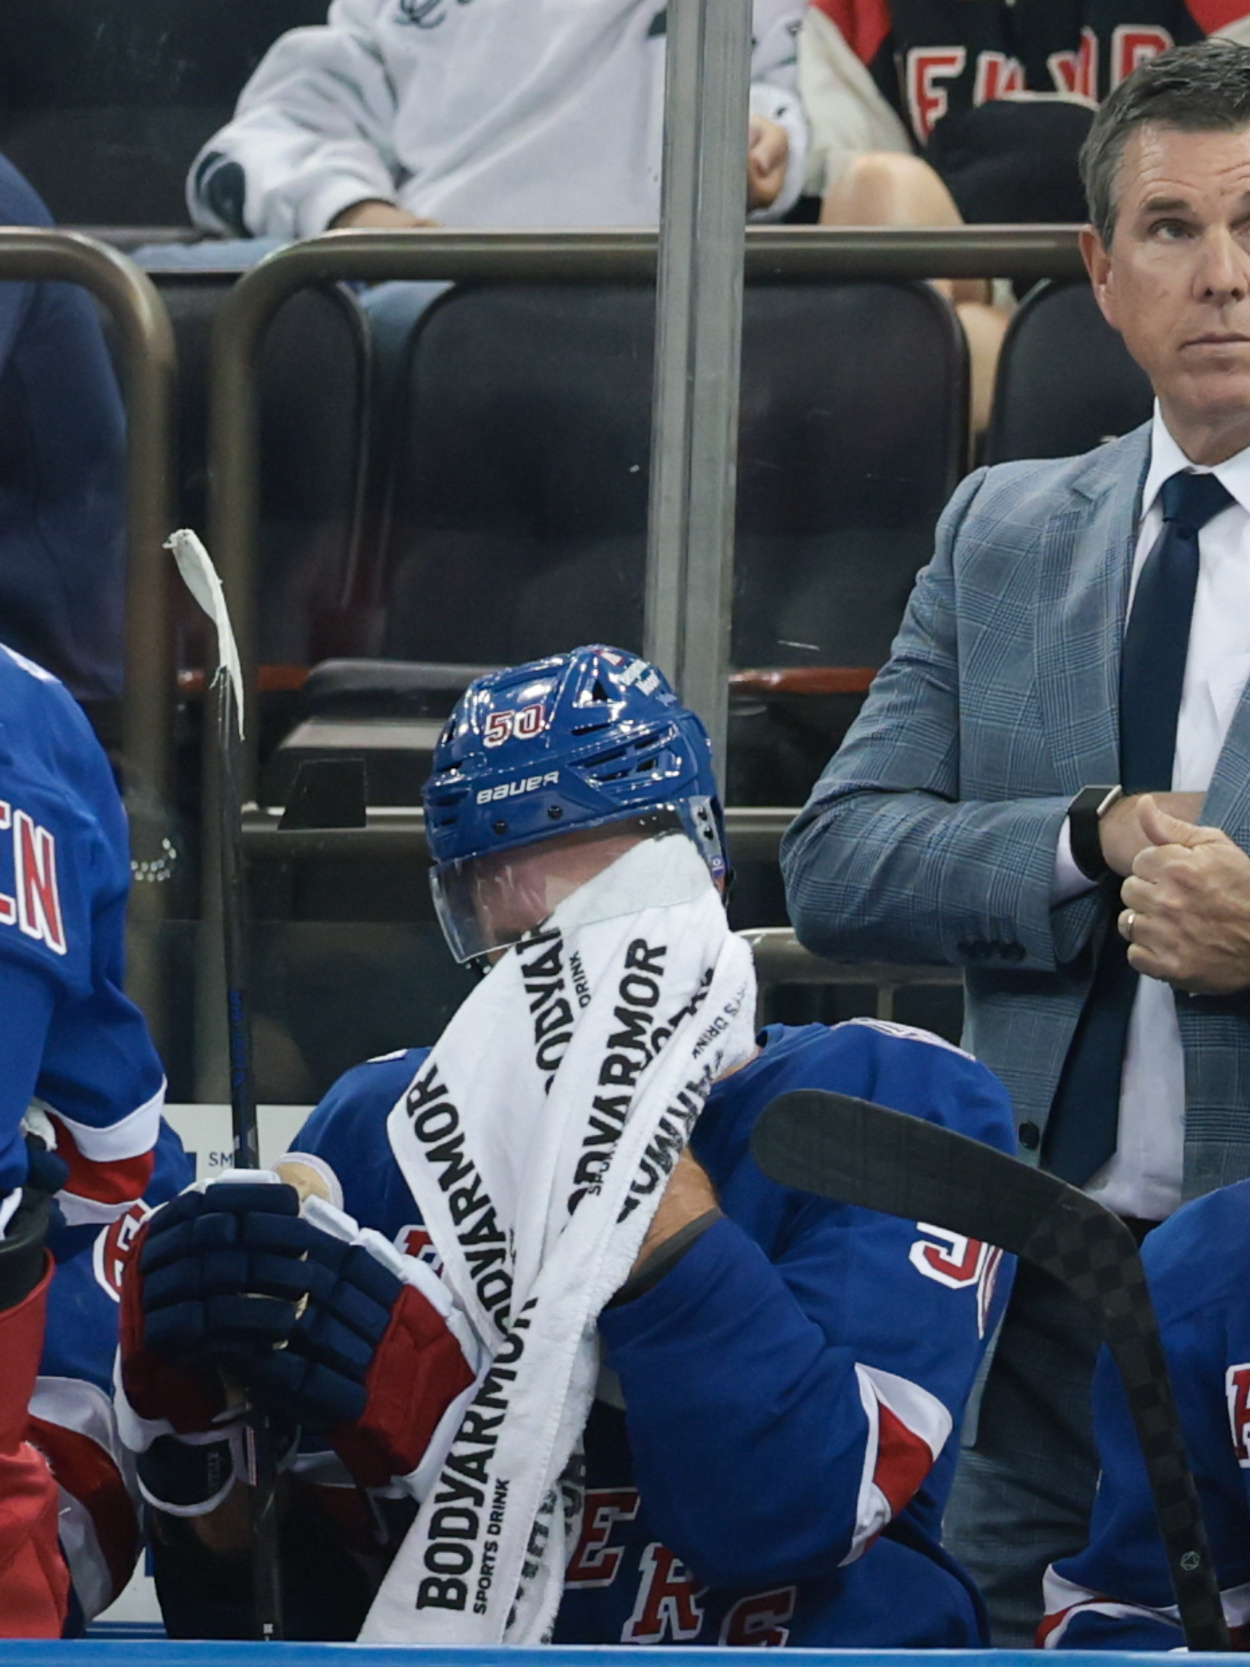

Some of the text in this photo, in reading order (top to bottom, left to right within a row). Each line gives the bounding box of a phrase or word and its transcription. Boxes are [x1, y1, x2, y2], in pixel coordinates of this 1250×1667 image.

[483, 703, 545, 748] 50
[476, 770, 560, 805] BAUER
[208, 1152, 234, 1168] SM
[473, 1478, 511, 1615] SPORTS DRINK
